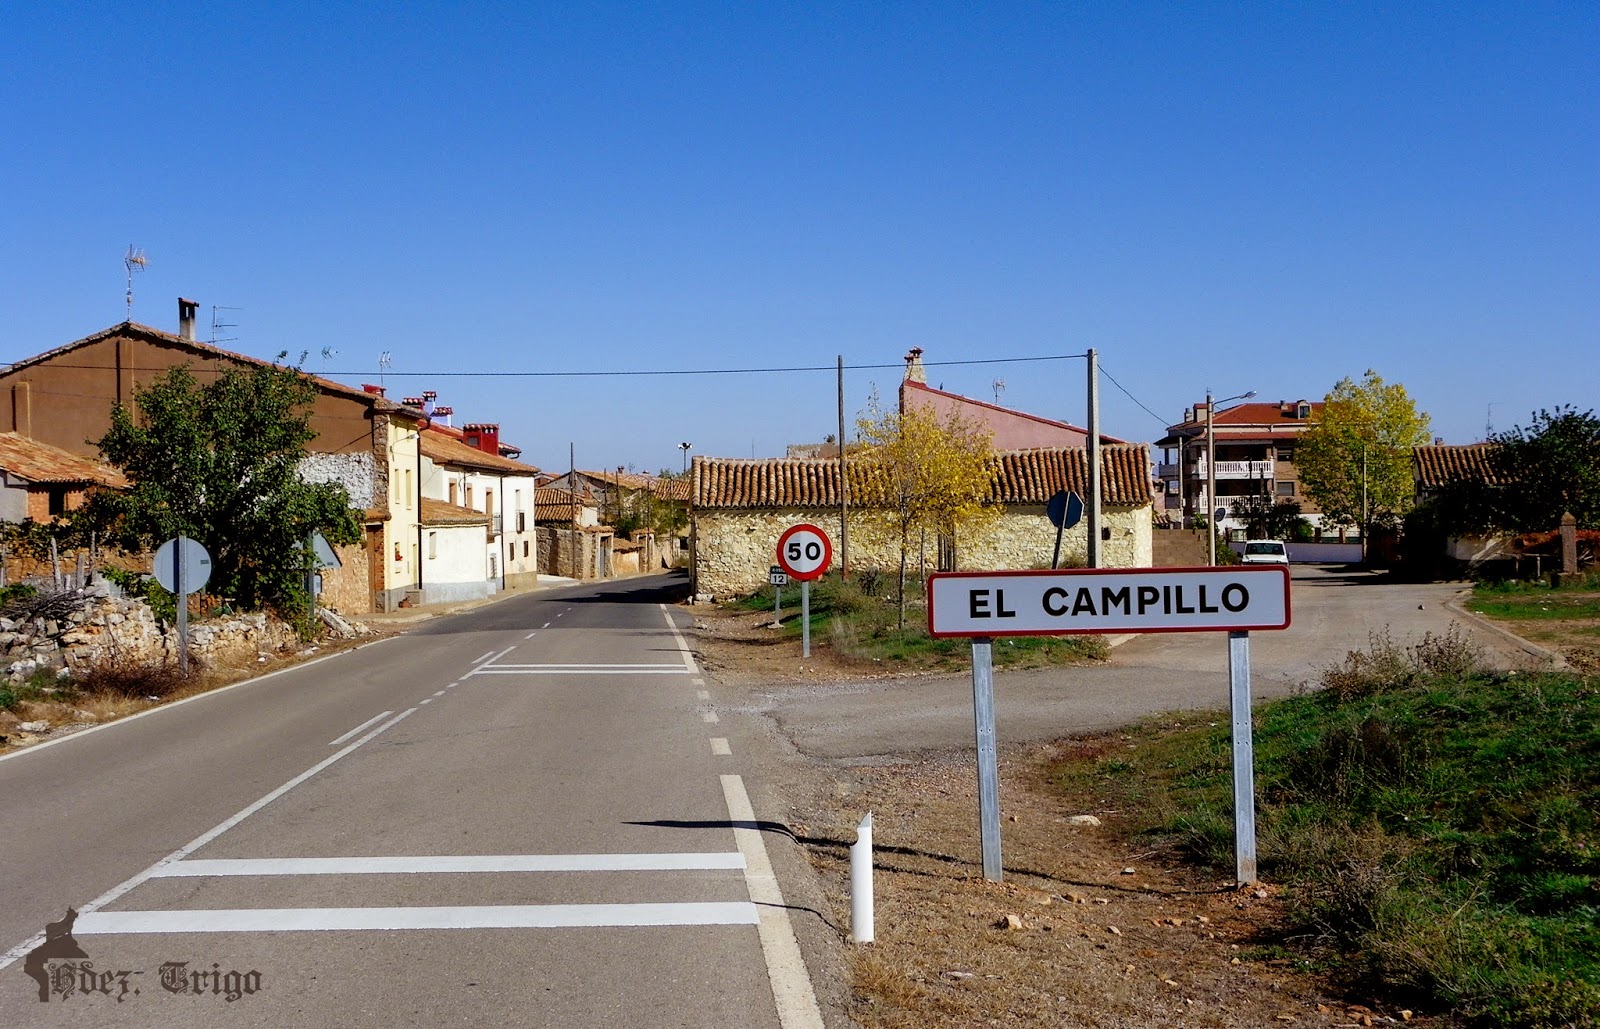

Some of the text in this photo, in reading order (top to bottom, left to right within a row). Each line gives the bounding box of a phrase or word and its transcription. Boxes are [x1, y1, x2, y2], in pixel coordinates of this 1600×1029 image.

[788, 542, 821, 561] 50
[773, 575, 784, 583] 12
[969, 582, 1250, 618] EL CAMPILLO
